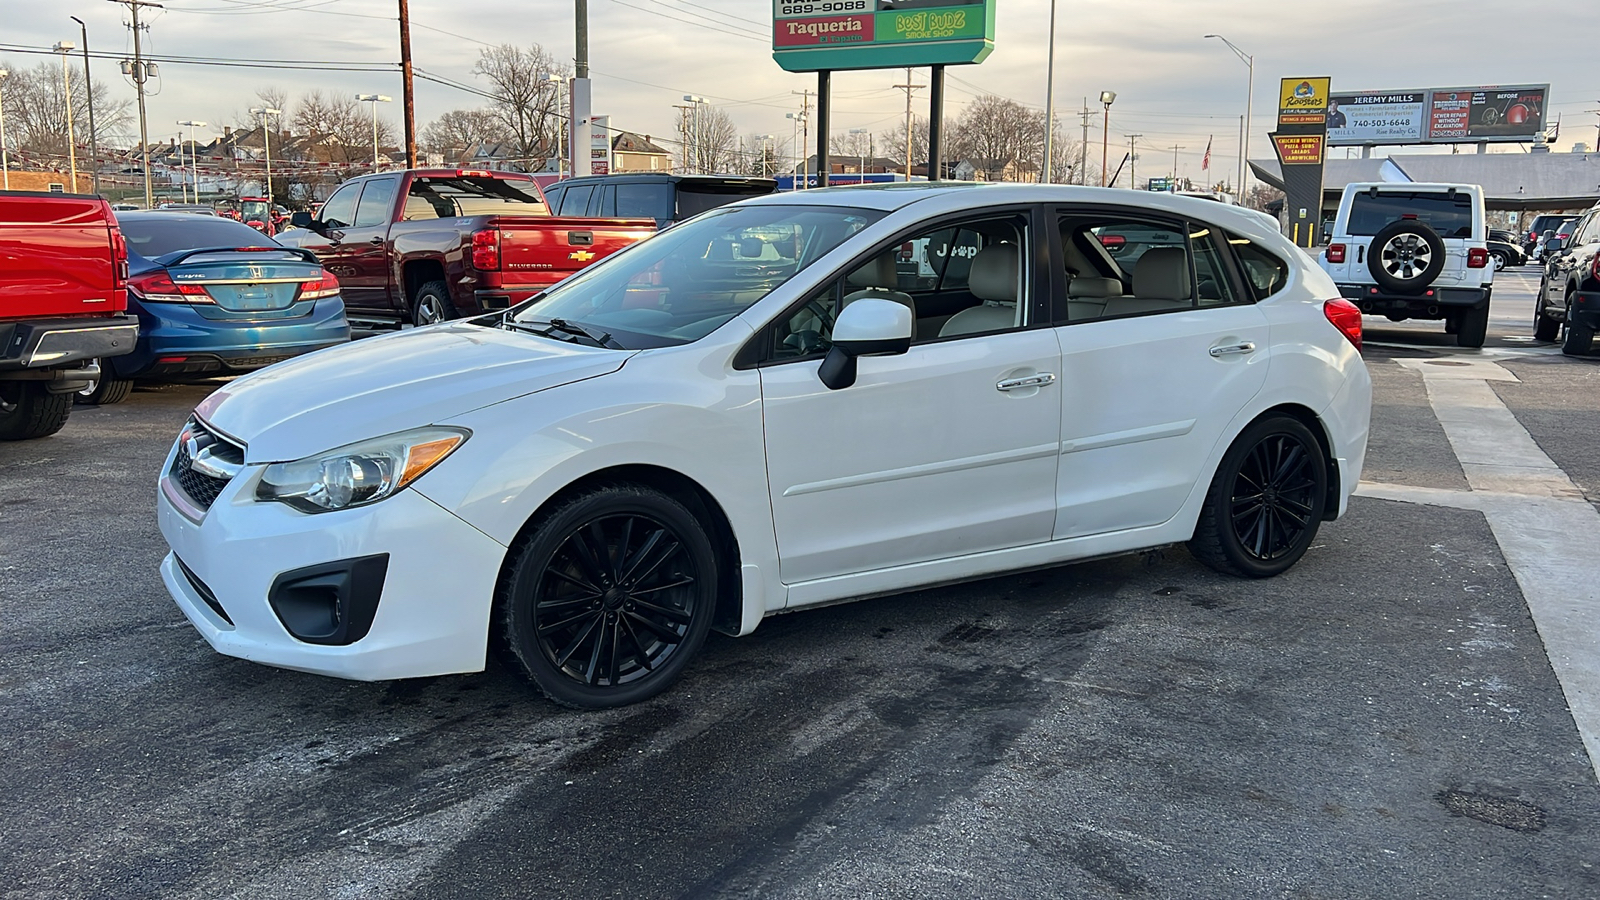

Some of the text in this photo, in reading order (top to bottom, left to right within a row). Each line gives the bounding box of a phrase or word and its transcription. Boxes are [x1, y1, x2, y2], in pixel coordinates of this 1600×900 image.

[782, 1, 866, 14] 689-9088
[929, 10, 966, 30] BUDZ
[906, 29, 954, 39] SMOKE SHOP
[1284, 96, 1322, 107] Roosters
[1354, 95, 1414, 104] JEREMY MILLS
[1353, 119, 1410, 127] 740-503-6648
[1388, 128, 1406, 136] Realty
